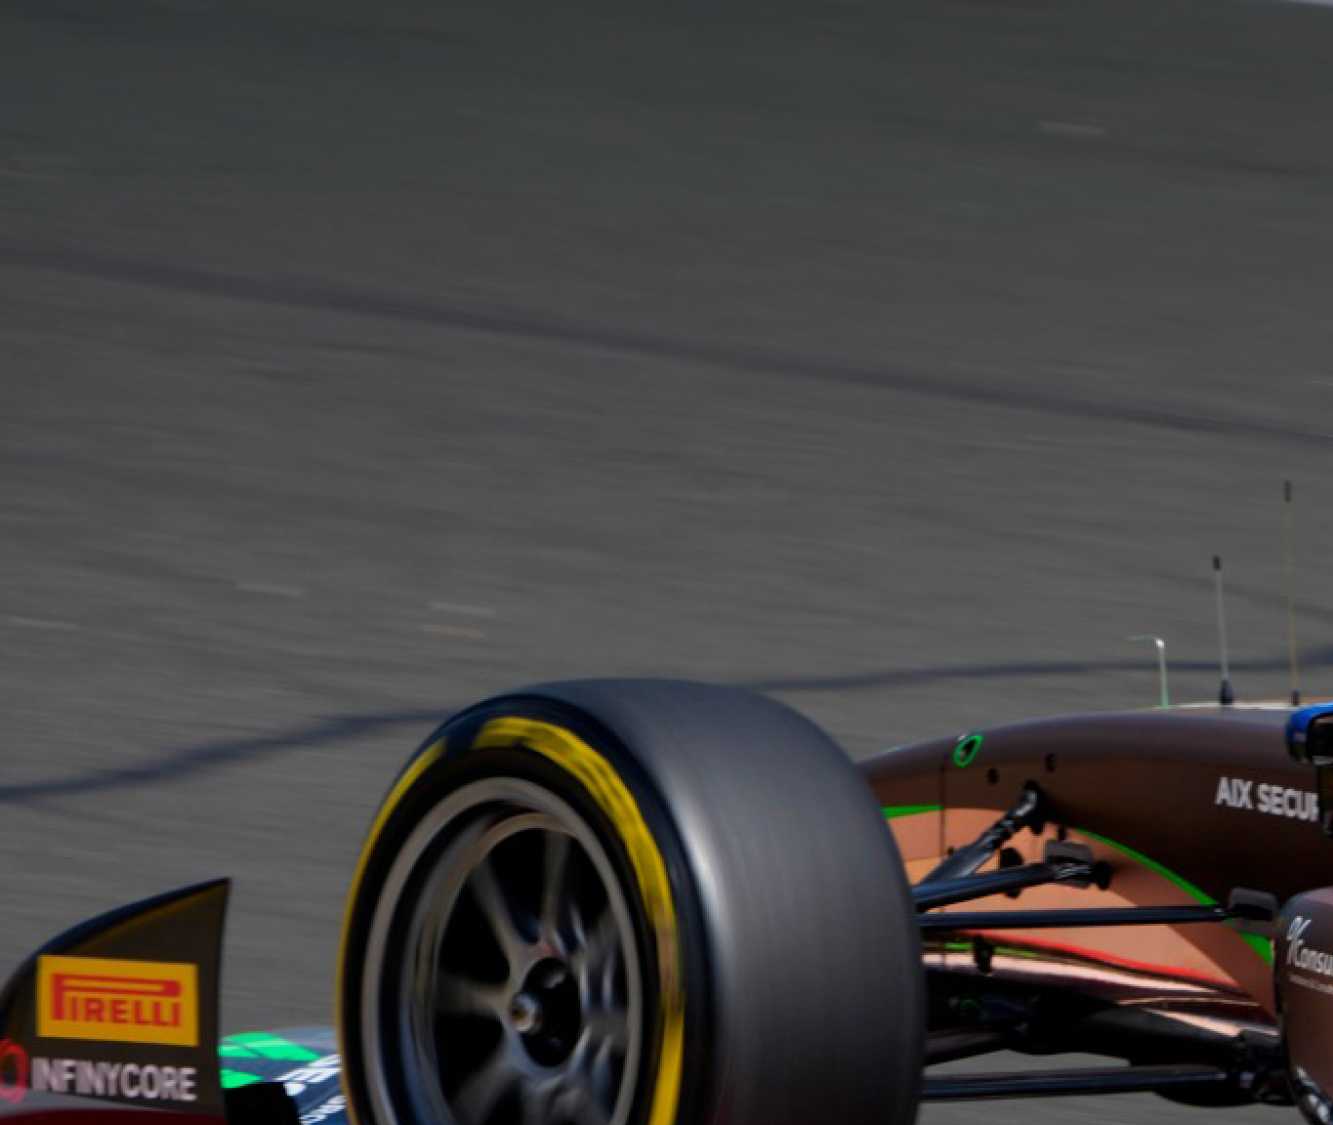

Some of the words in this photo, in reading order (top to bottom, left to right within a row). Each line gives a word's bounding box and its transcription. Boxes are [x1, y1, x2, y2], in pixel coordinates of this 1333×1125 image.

[1214, 776, 1254, 810] AIX
[50, 972, 183, 1028] PIRELLI
[31, 1056, 198, 1101] INFINYCORE
